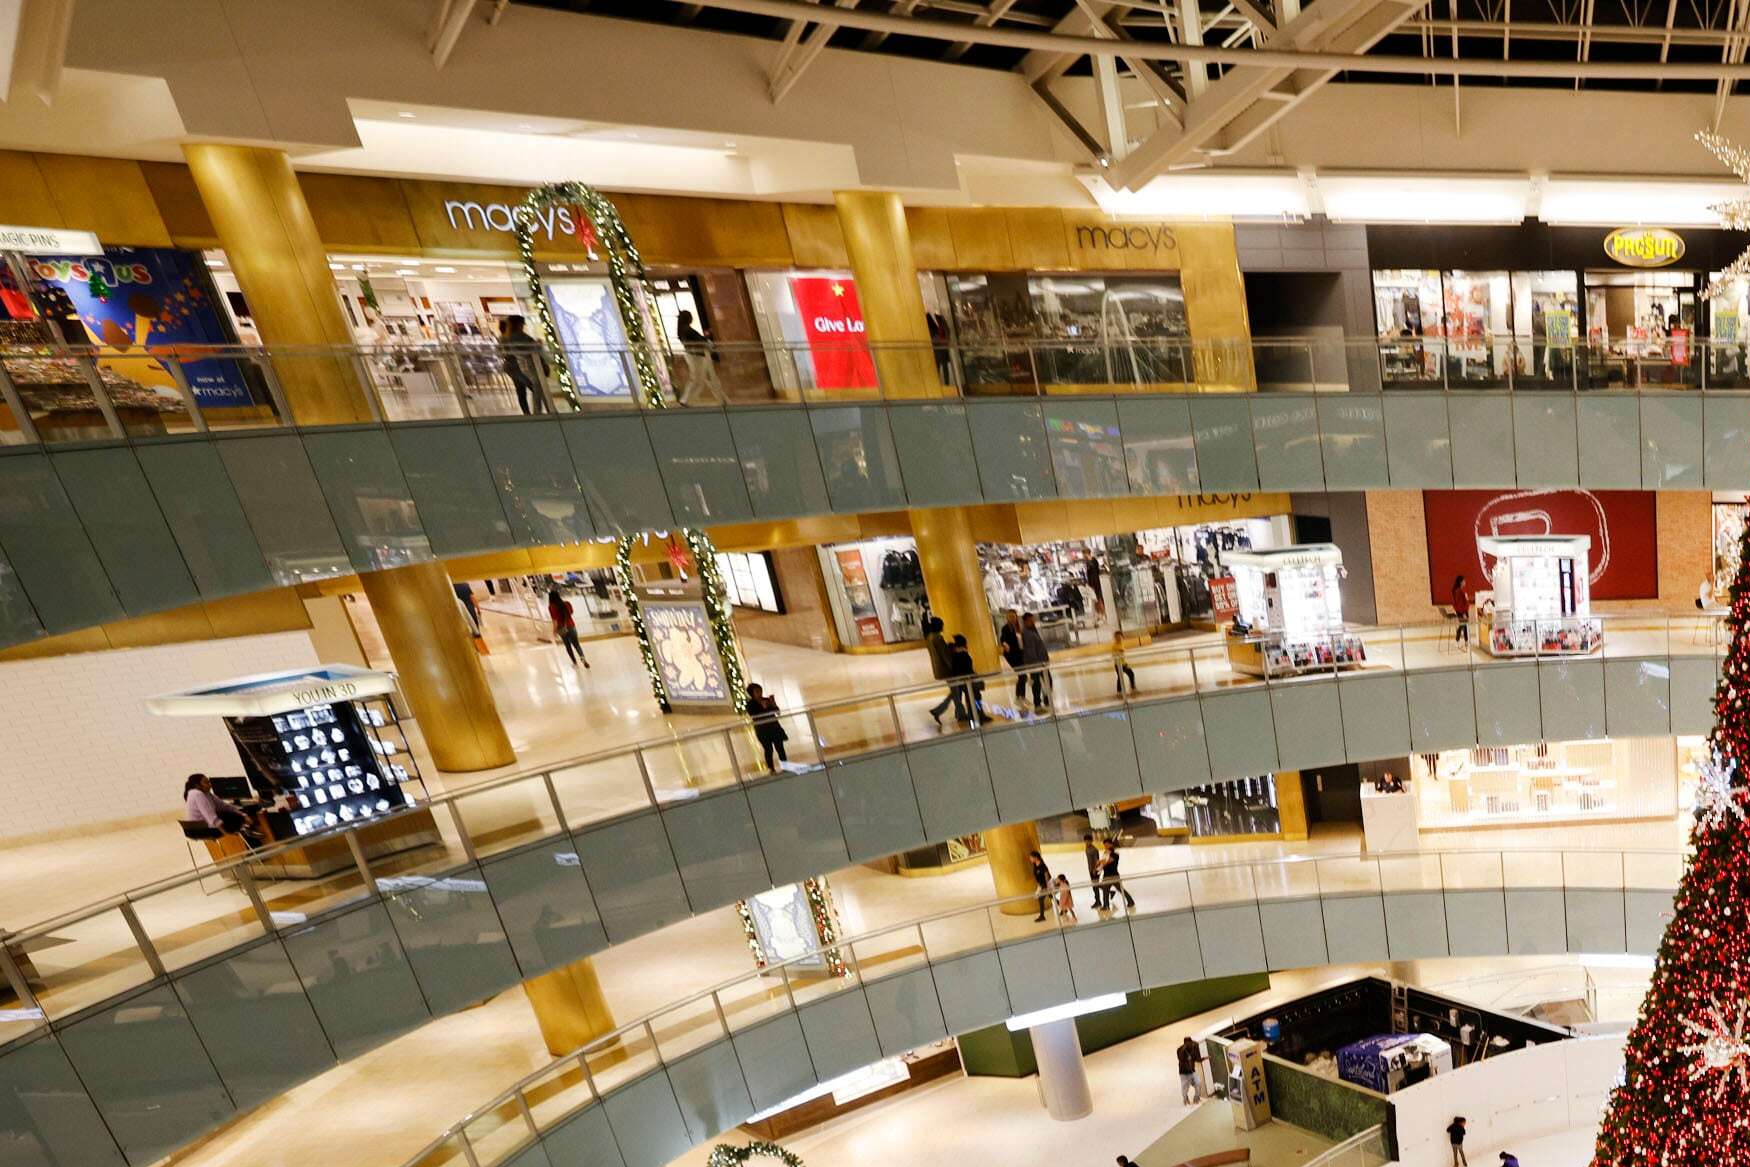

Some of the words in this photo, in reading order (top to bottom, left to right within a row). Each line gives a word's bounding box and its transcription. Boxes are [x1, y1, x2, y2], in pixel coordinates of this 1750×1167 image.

[1076, 222, 1177, 255] macy's
[814, 316, 845, 332] Give
[293, 687, 319, 705] YOU
[321, 686, 337, 702] IN
[339, 682, 357, 697] 3D
[1251, 1066, 1265, 1107] ATM
